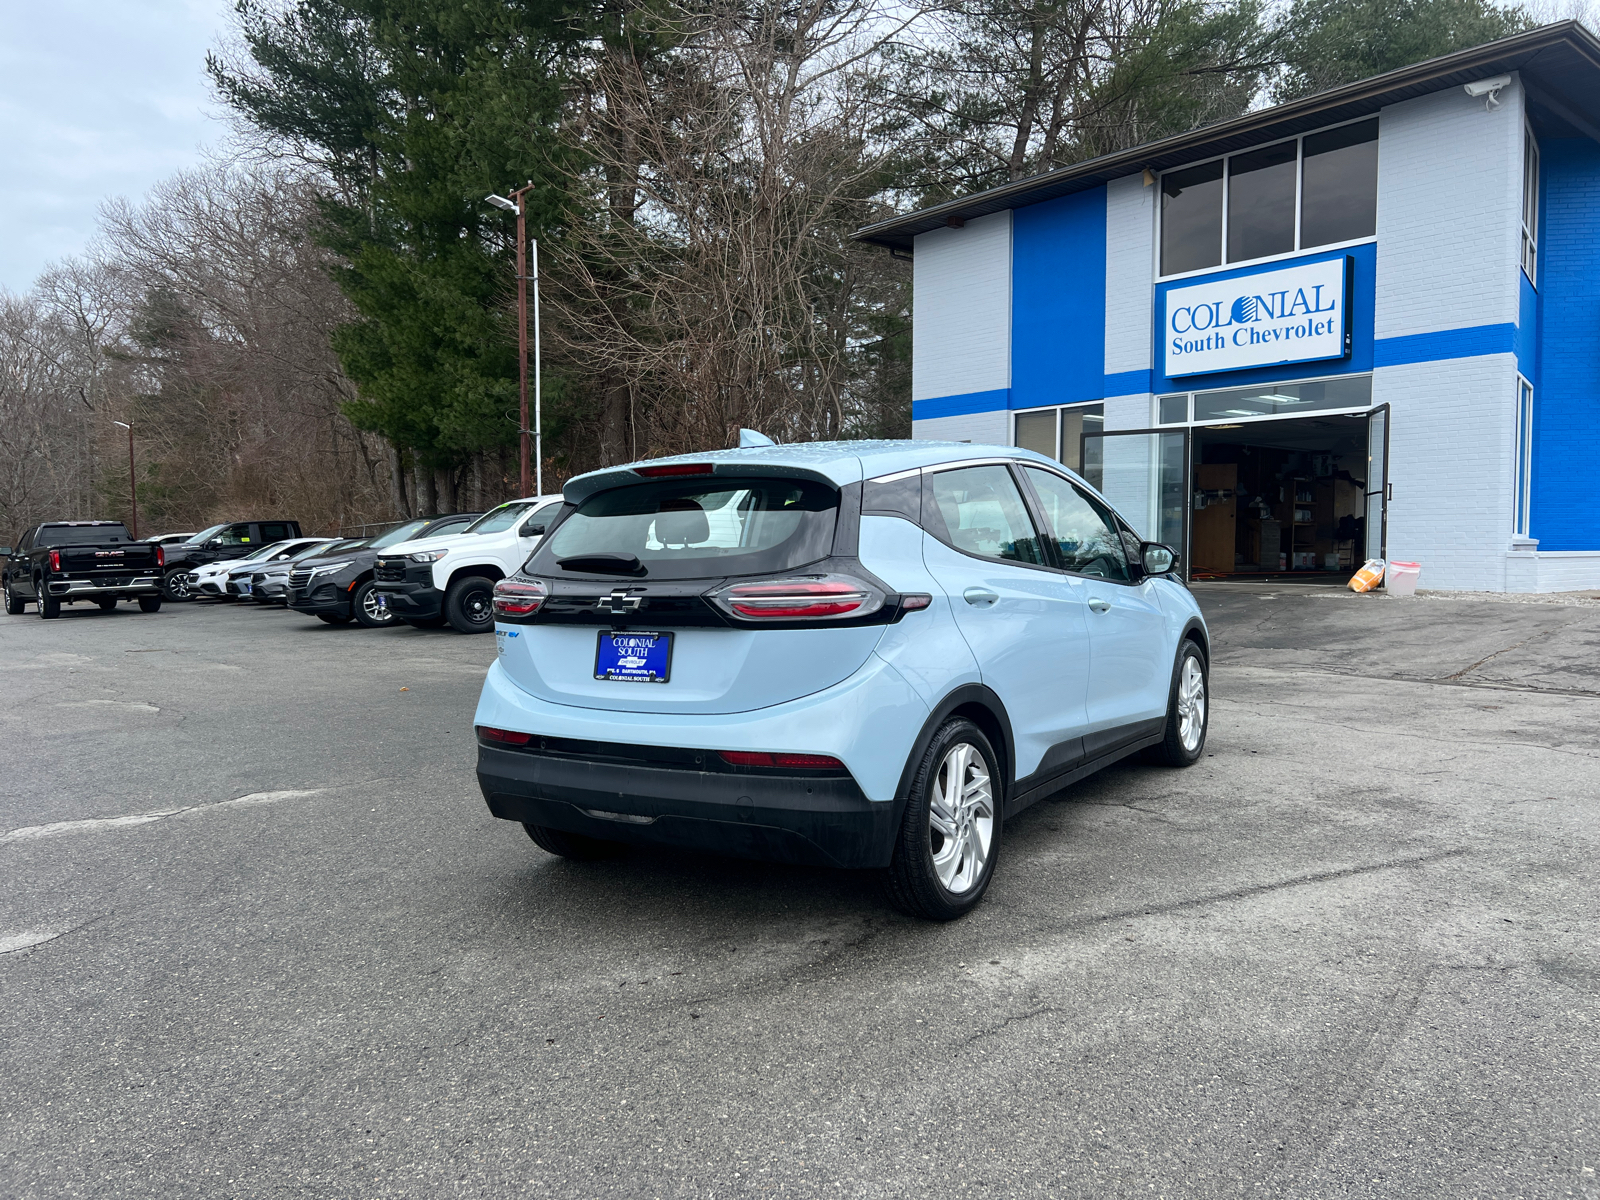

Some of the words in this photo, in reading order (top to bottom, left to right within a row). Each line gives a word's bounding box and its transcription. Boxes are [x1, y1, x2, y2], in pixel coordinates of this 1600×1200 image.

[1171, 284, 1336, 334] COLONIAL
[1172, 331, 1226, 356] South
[1232, 317, 1335, 347] Chevrolet
[613, 638, 656, 648] COLONIAL
[618, 647, 648, 656] SOUTH
